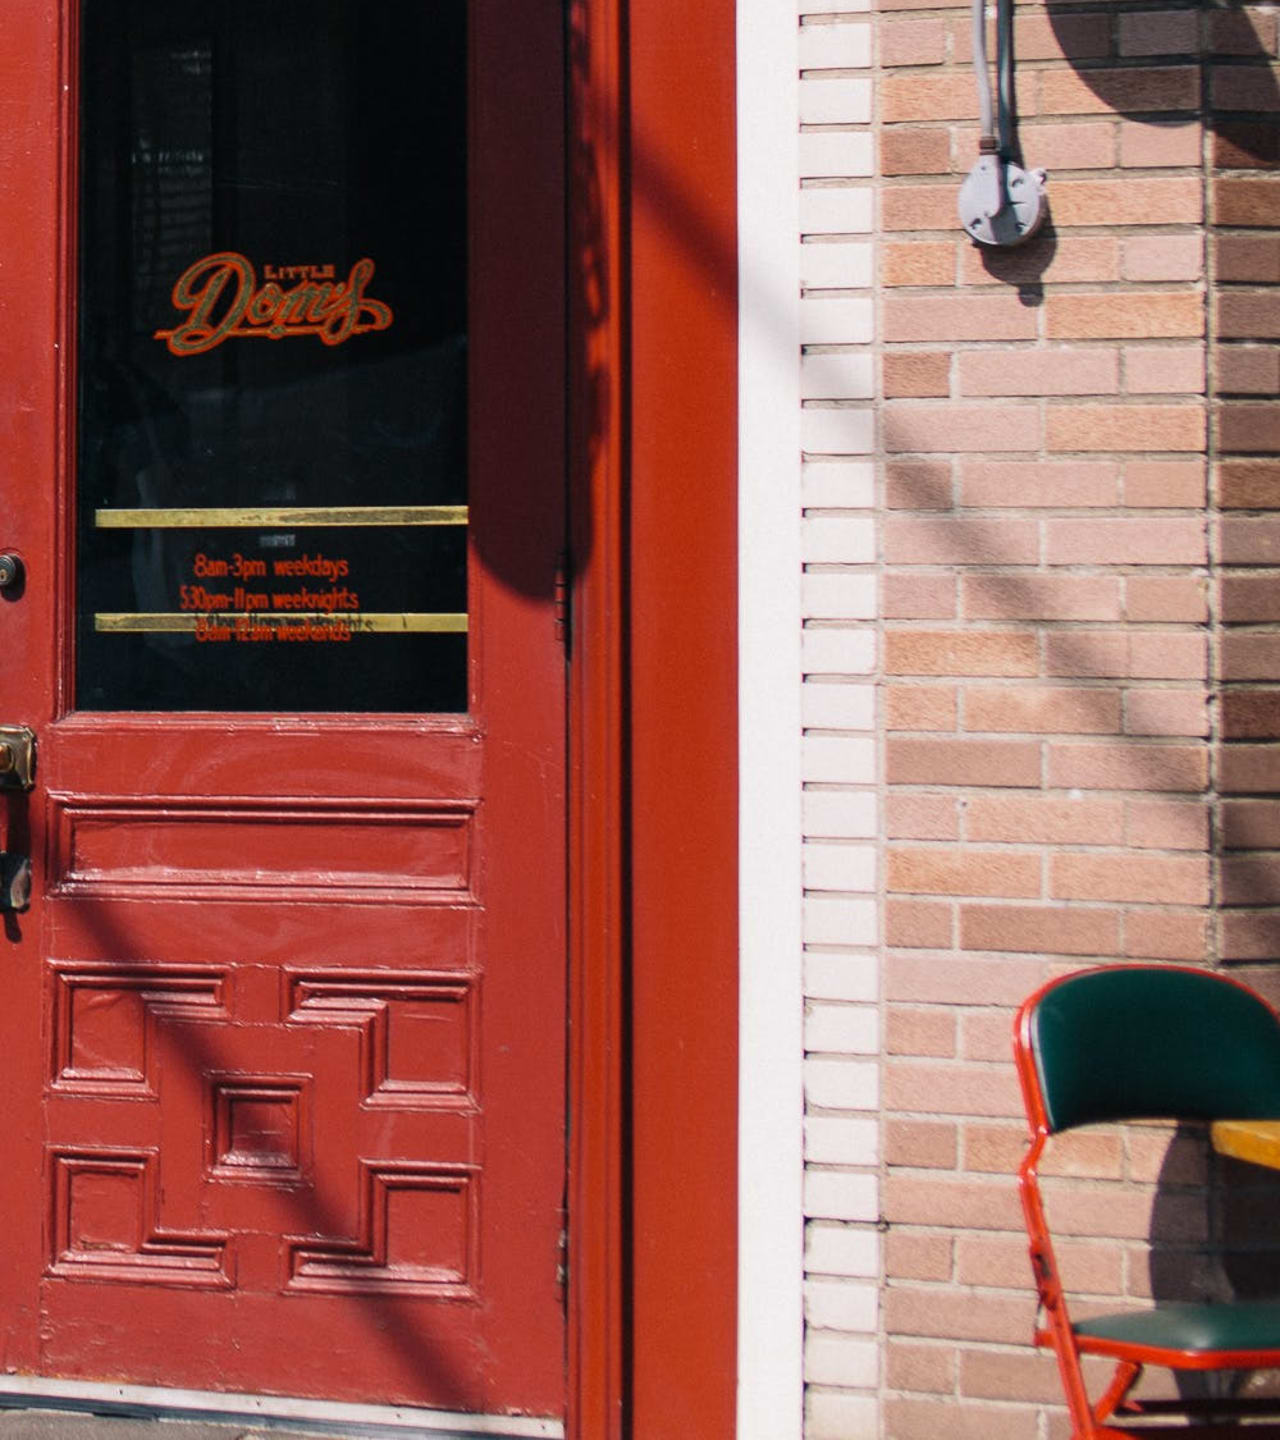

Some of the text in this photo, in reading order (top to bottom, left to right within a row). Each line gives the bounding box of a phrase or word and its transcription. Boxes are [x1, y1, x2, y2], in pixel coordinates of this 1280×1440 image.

[263, 264, 335, 280] LITTLE
[194, 552, 349, 582] 8am-3pm weekdays
[272, 586, 359, 614] weeknights
